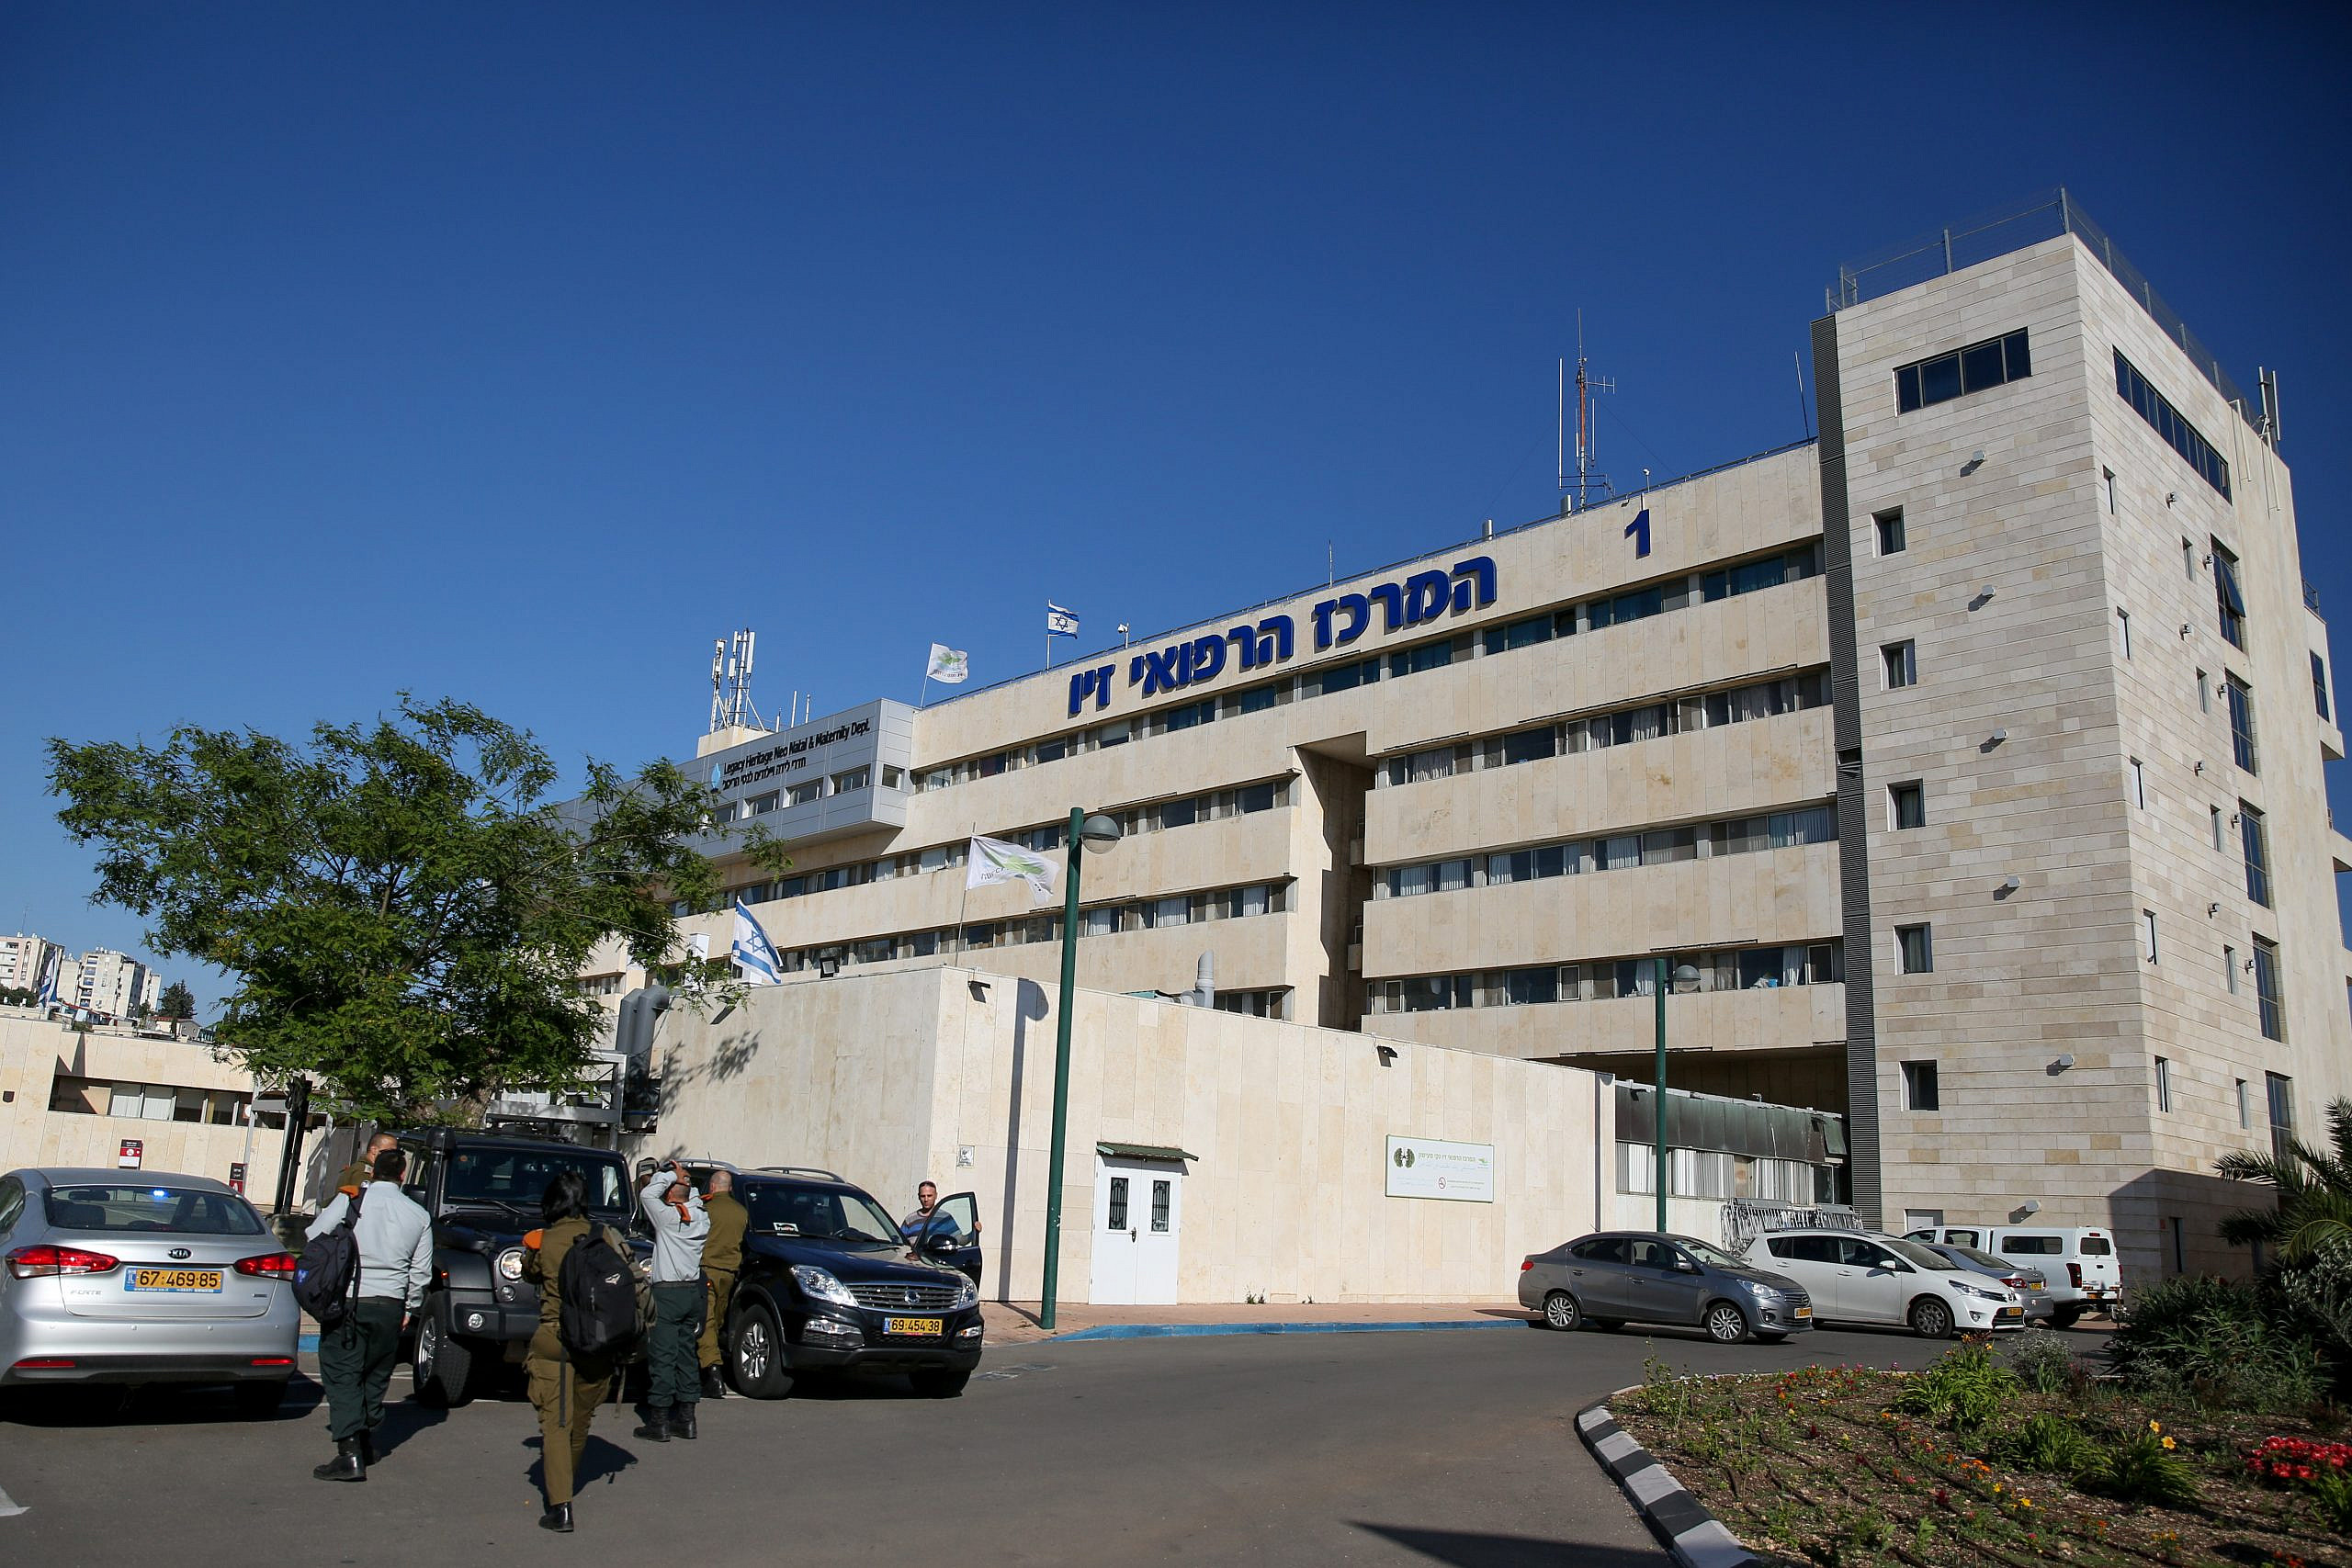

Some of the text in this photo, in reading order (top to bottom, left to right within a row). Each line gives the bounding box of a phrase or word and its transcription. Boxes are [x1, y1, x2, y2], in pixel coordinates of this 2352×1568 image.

[1625, 509, 1650, 557] 1
[1069, 556, 1496, 715] המרכז הרפואי זיו
[724, 717, 871, 776] Legacy Heritage Neo Natal & Maternity Dept.
[172, 1249, 188, 1258] KIA
